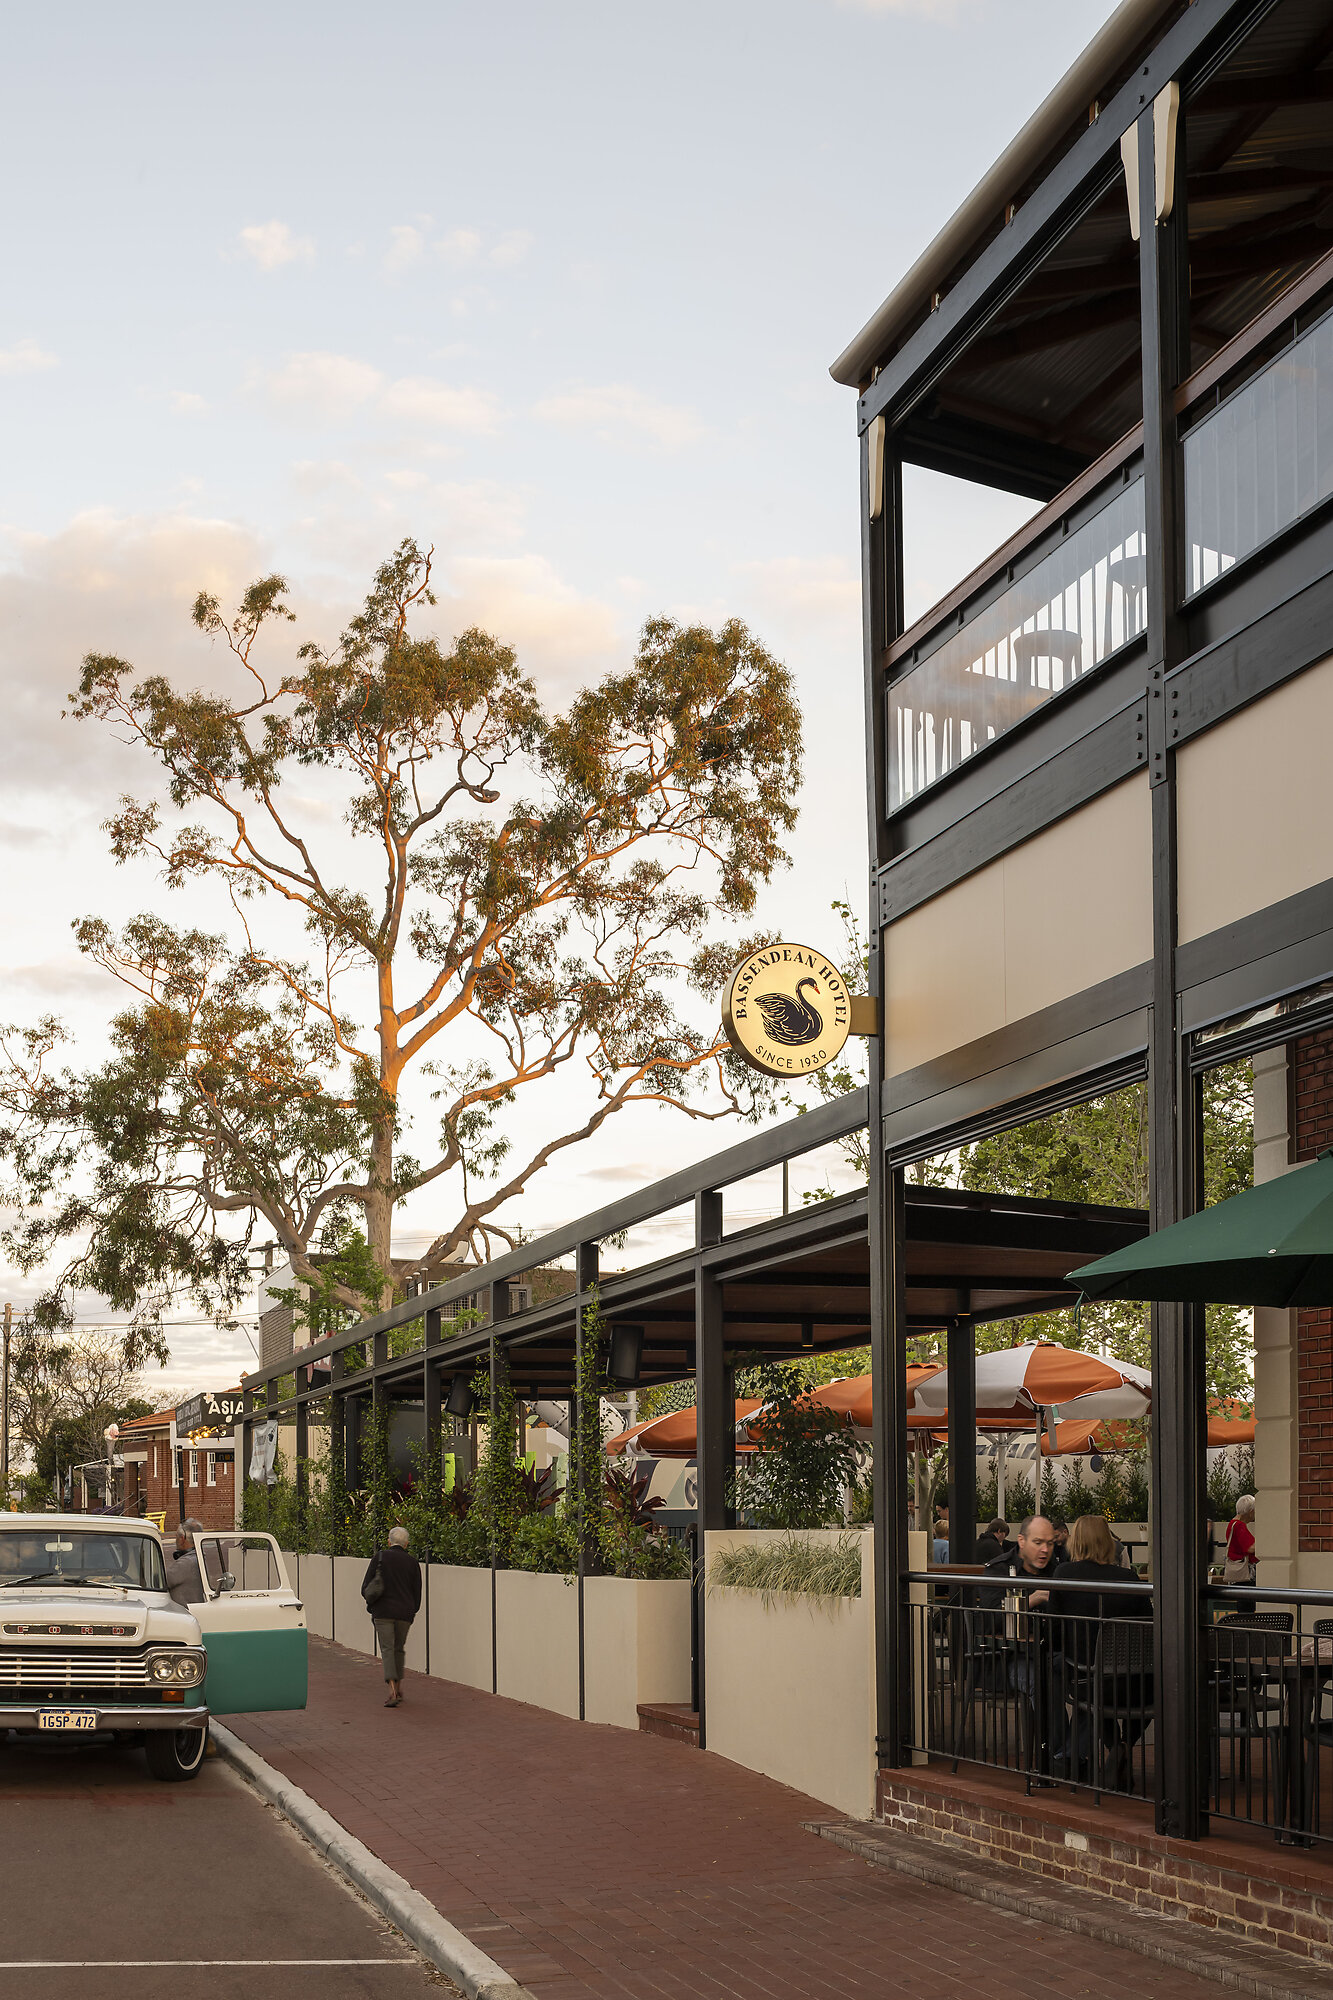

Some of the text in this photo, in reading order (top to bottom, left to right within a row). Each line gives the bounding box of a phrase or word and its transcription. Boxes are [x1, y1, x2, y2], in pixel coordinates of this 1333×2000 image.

[736, 949, 847, 1027] BASSENDEAN HOTEL
[755, 1045, 827, 1069] SINCE 1930
[17, 1625, 124, 1635] FORD
